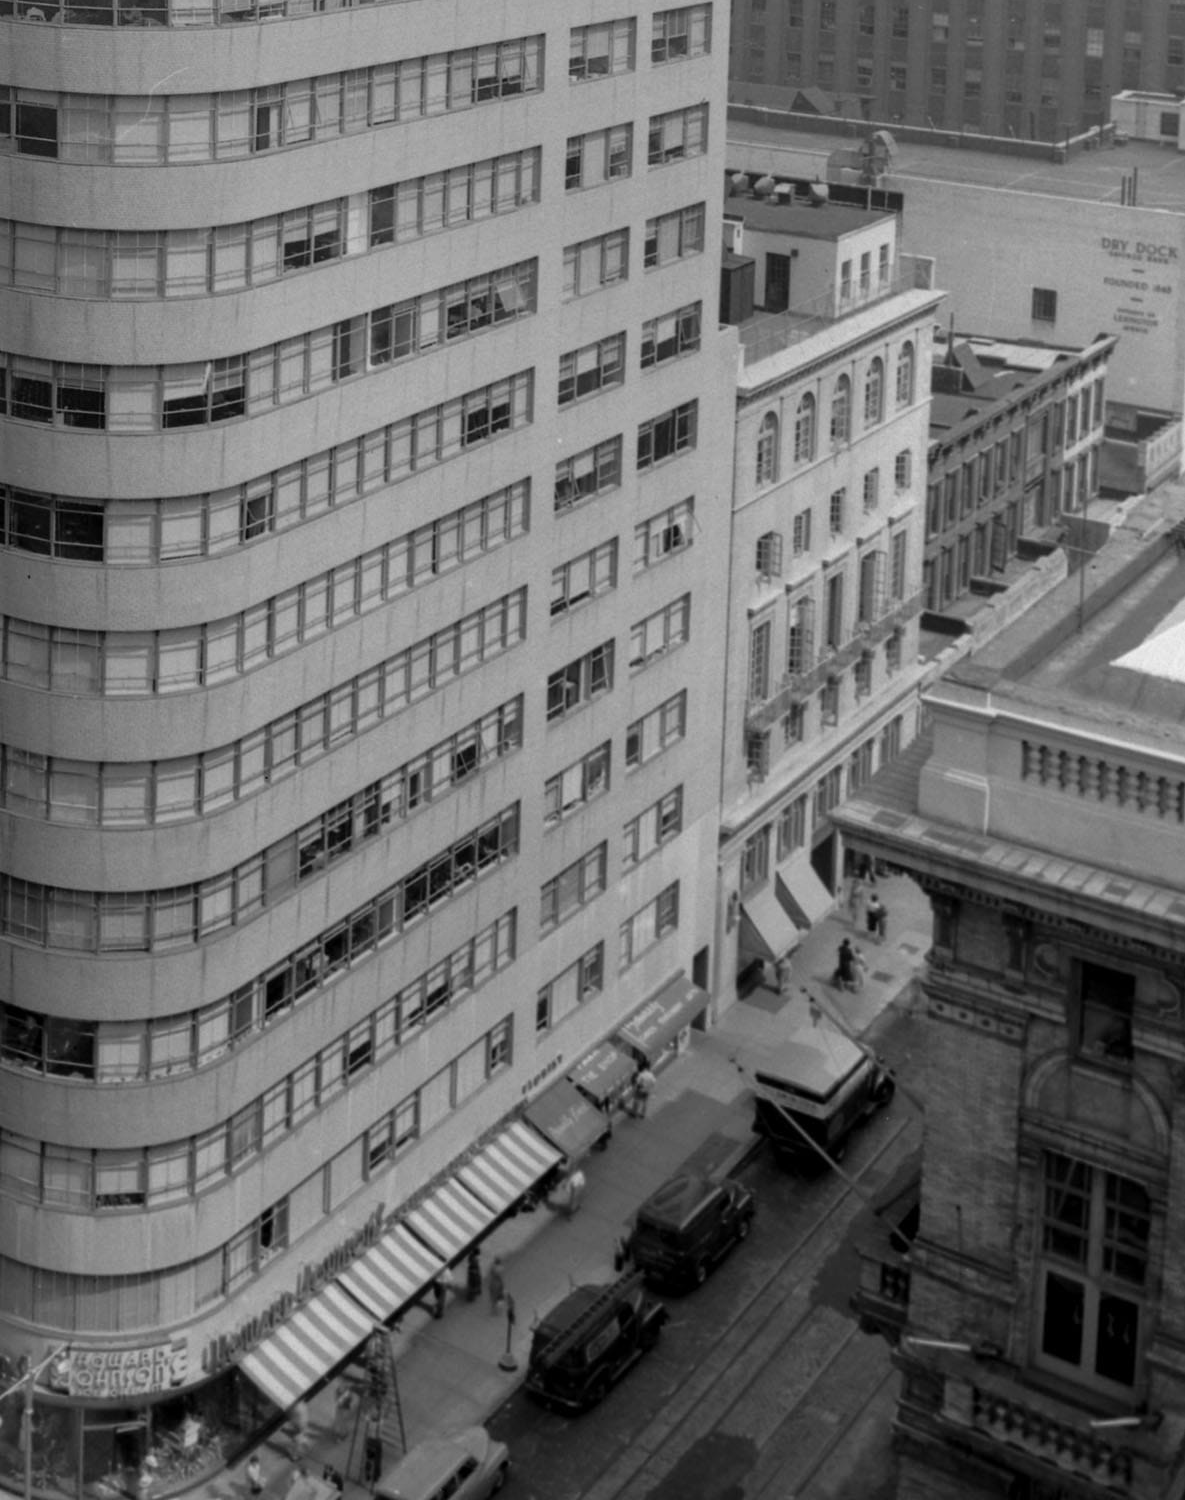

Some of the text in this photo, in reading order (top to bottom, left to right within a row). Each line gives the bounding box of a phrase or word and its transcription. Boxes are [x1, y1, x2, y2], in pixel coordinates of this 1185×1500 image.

[1101, 237, 1178, 259] DRY DOCK
[1103, 277, 1148, 290] FOUNDED
[73, 1349, 165, 1369] HOWARD
